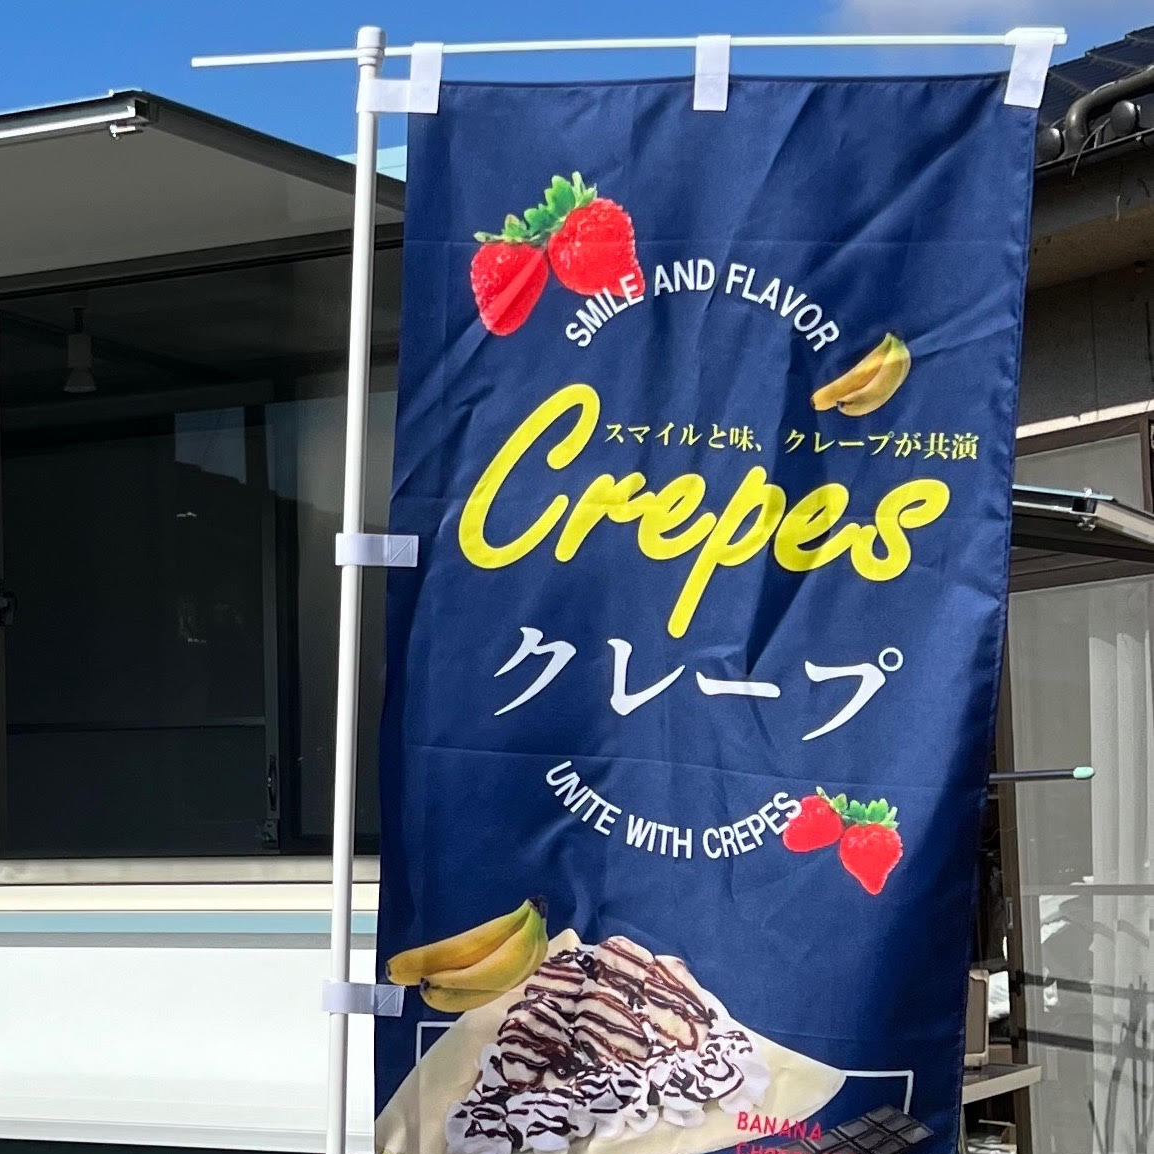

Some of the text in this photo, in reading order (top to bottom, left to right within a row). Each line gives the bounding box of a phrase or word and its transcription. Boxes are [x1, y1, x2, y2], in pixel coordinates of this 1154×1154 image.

[565, 258, 840, 352] SMILE AND FLAVOR
[784, 429, 980, 460] クレープが共演
[458, 383, 950, 638] Crepes
[494, 626, 904, 741] クレープ
[546, 760, 803, 859] UNITE WITH CREPES
[737, 1111, 823, 1142] BANANA
